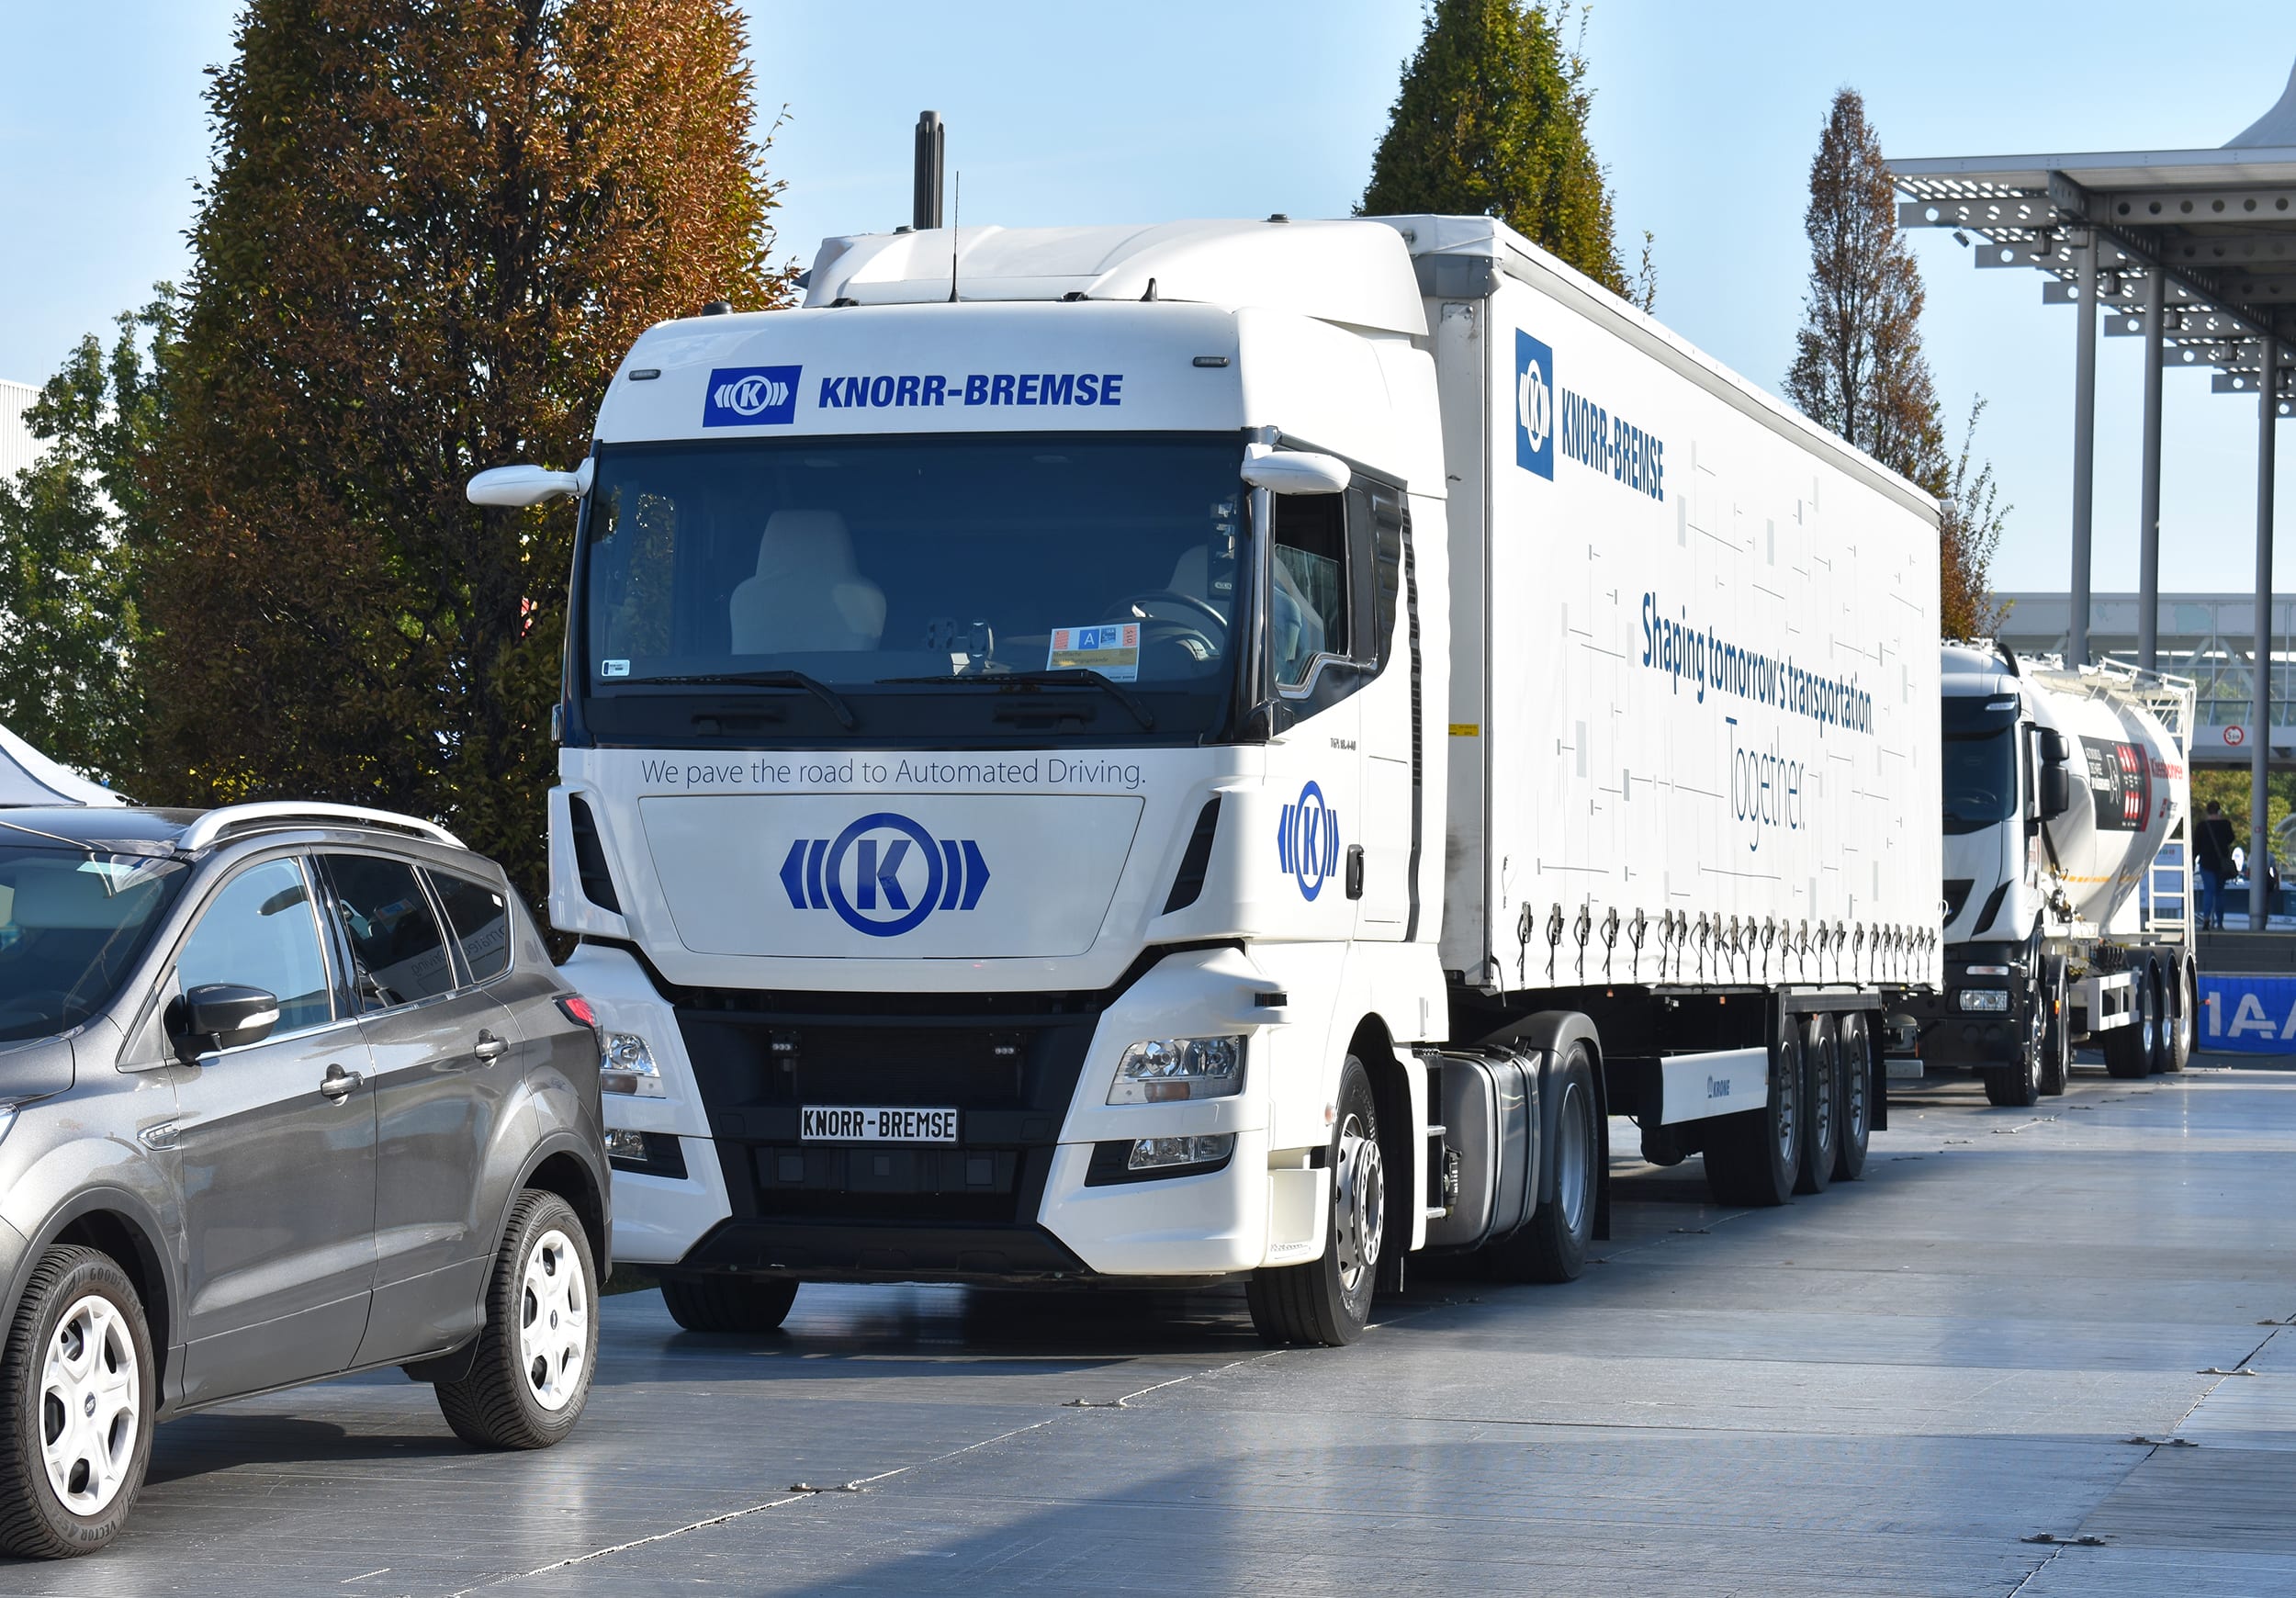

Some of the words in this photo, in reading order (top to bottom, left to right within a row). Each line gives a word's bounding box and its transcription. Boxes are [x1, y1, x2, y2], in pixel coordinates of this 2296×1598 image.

[819, 373, 1123, 409] KNORR-BREMSE
[1562, 387, 1663, 502] KNORR-BREMSE
[1084, 633, 1095, 646] A
[1642, 591, 1705, 704] Shaping
[1708, 625, 1785, 711] tomorrow's
[642, 760, 679, 783] We
[687, 765, 743, 790] pave
[751, 758, 791, 783] the
[801, 758, 853, 783] road
[862, 761, 887, 783] to
[895, 757, 1038, 783] Automated
[1049, 759, 1145, 790] Driving.
[1726, 716, 1806, 852] Together.
[857, 839, 912, 910] K
[804, 1109, 955, 1139] KNORR-BREMSE
[89, 1266, 143, 1325] GOODYEAR
[80, 1520, 117, 1542] VECTOR
